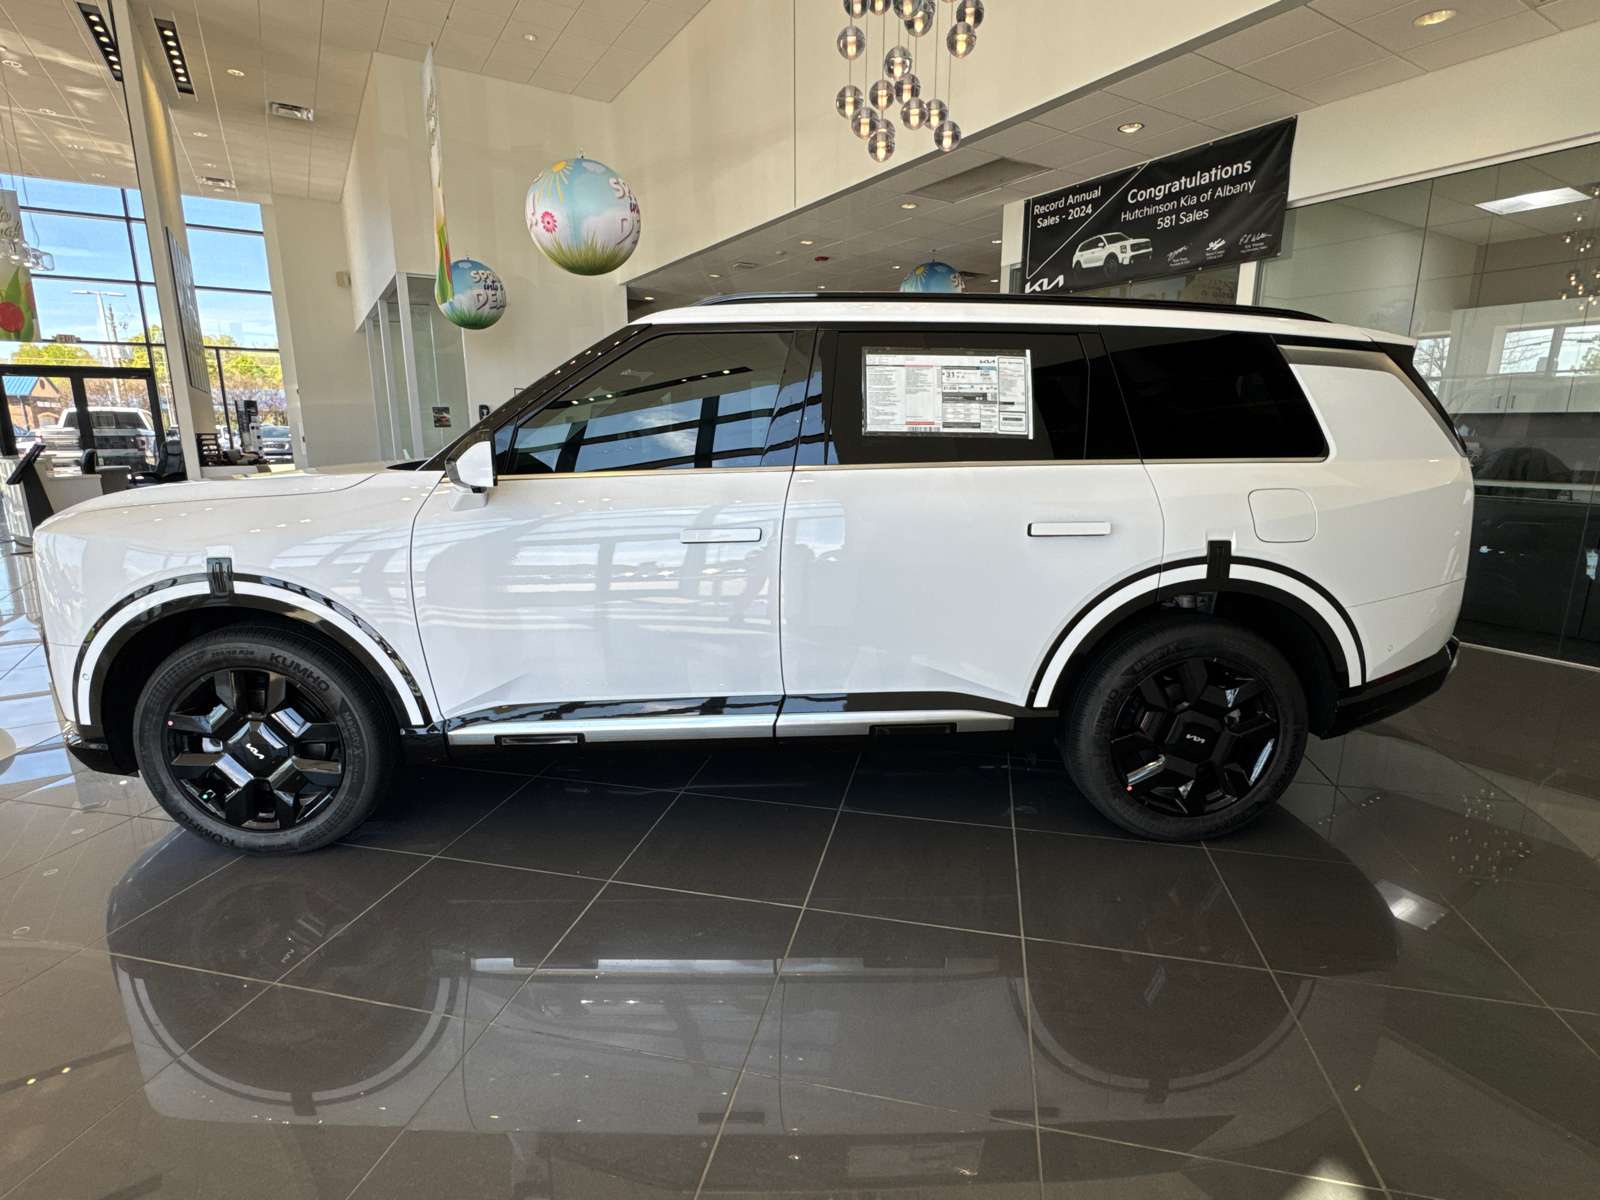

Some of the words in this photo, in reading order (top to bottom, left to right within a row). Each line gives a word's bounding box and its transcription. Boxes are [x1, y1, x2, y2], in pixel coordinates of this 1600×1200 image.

[1127, 160, 1252, 204] Congratulations
[1033, 197, 1065, 216] Record
[1066, 185, 1102, 206] Annual
[1036, 214, 1060, 229] Sales
[1067, 203, 1093, 220] 2024
[1120, 200, 1177, 222] Hutchinson
[1179, 195, 1197, 208] Kia
[1199, 188, 1213, 203] of
[1213, 180, 1257, 200] Albany
[1156, 214, 1176, 230] 581
[1178, 208, 1210, 225] Sales
[1024, 274, 1064, 294] KIA
[269, 652, 331, 692] KUMHO
[342, 711, 360, 744] Majesty
[176, 811, 235, 847] KUMHO
